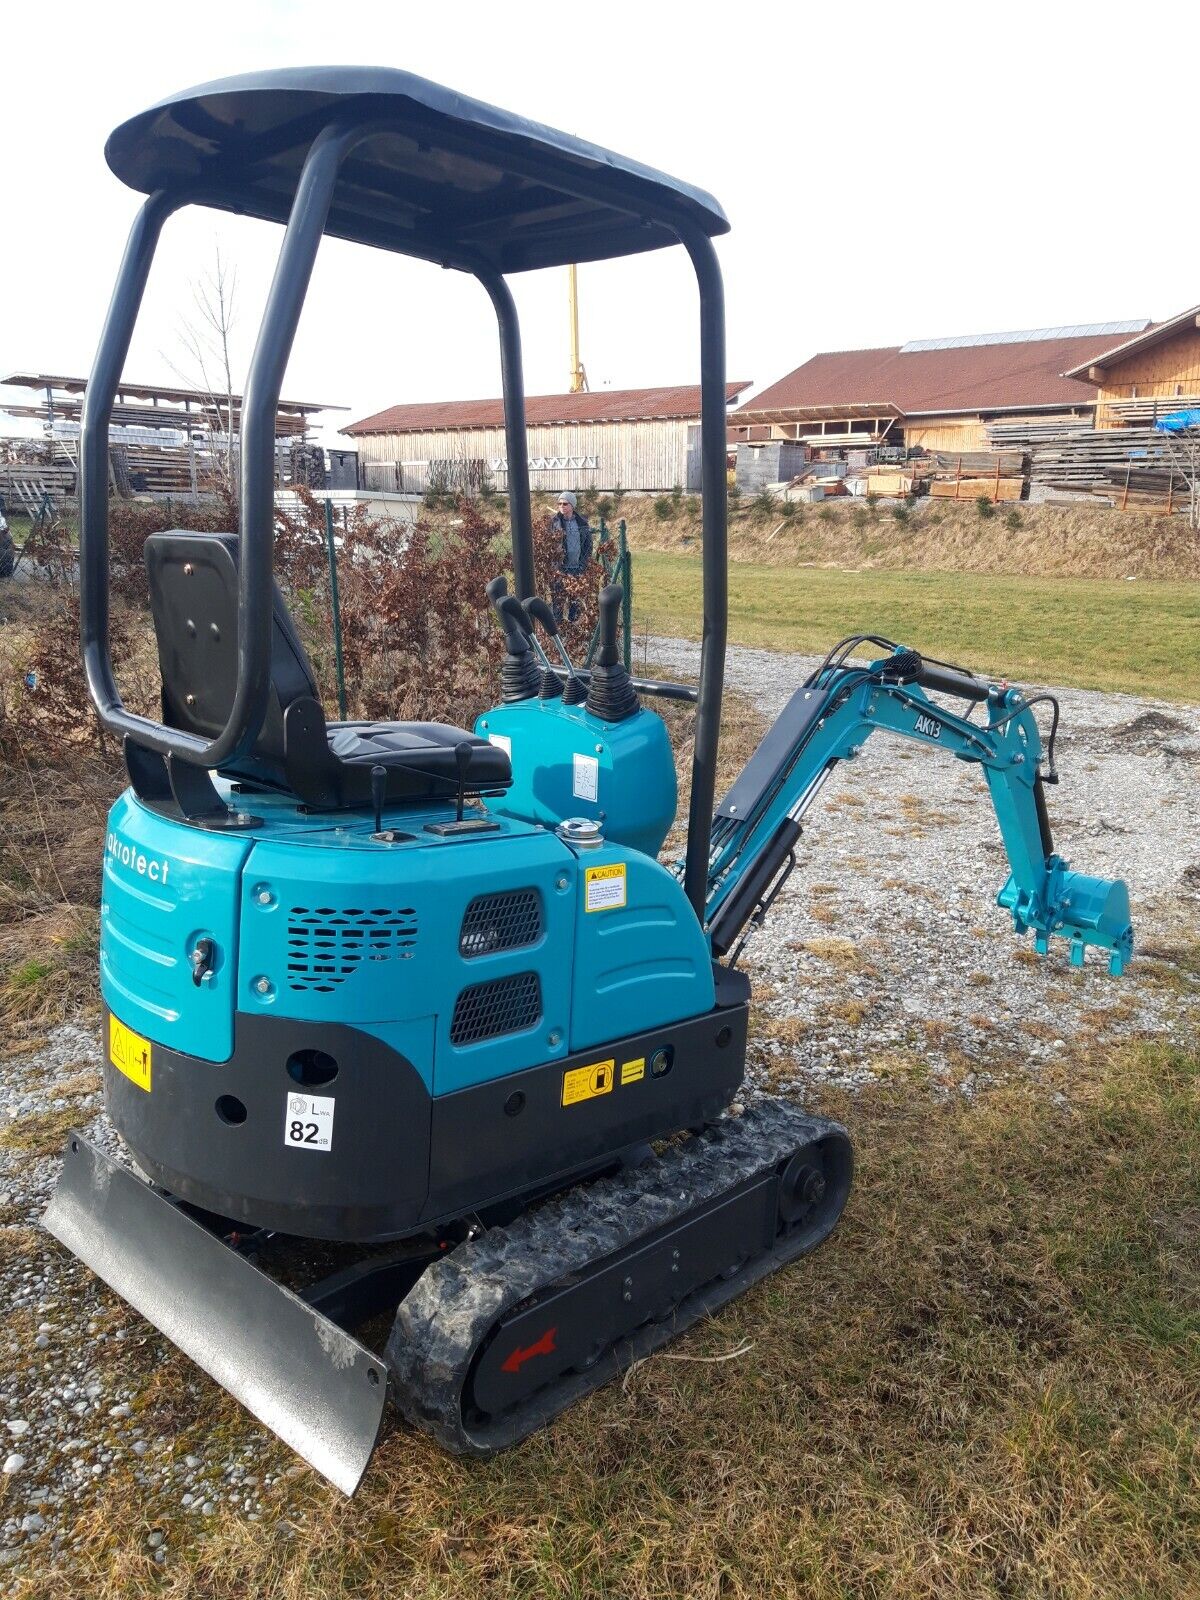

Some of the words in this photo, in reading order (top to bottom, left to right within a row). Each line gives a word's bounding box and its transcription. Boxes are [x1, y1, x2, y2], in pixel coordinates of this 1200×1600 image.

[914, 714, 942, 738] AK13
[107, 833, 169, 885] akrotect
[597, 868, 623, 879] CAUTION
